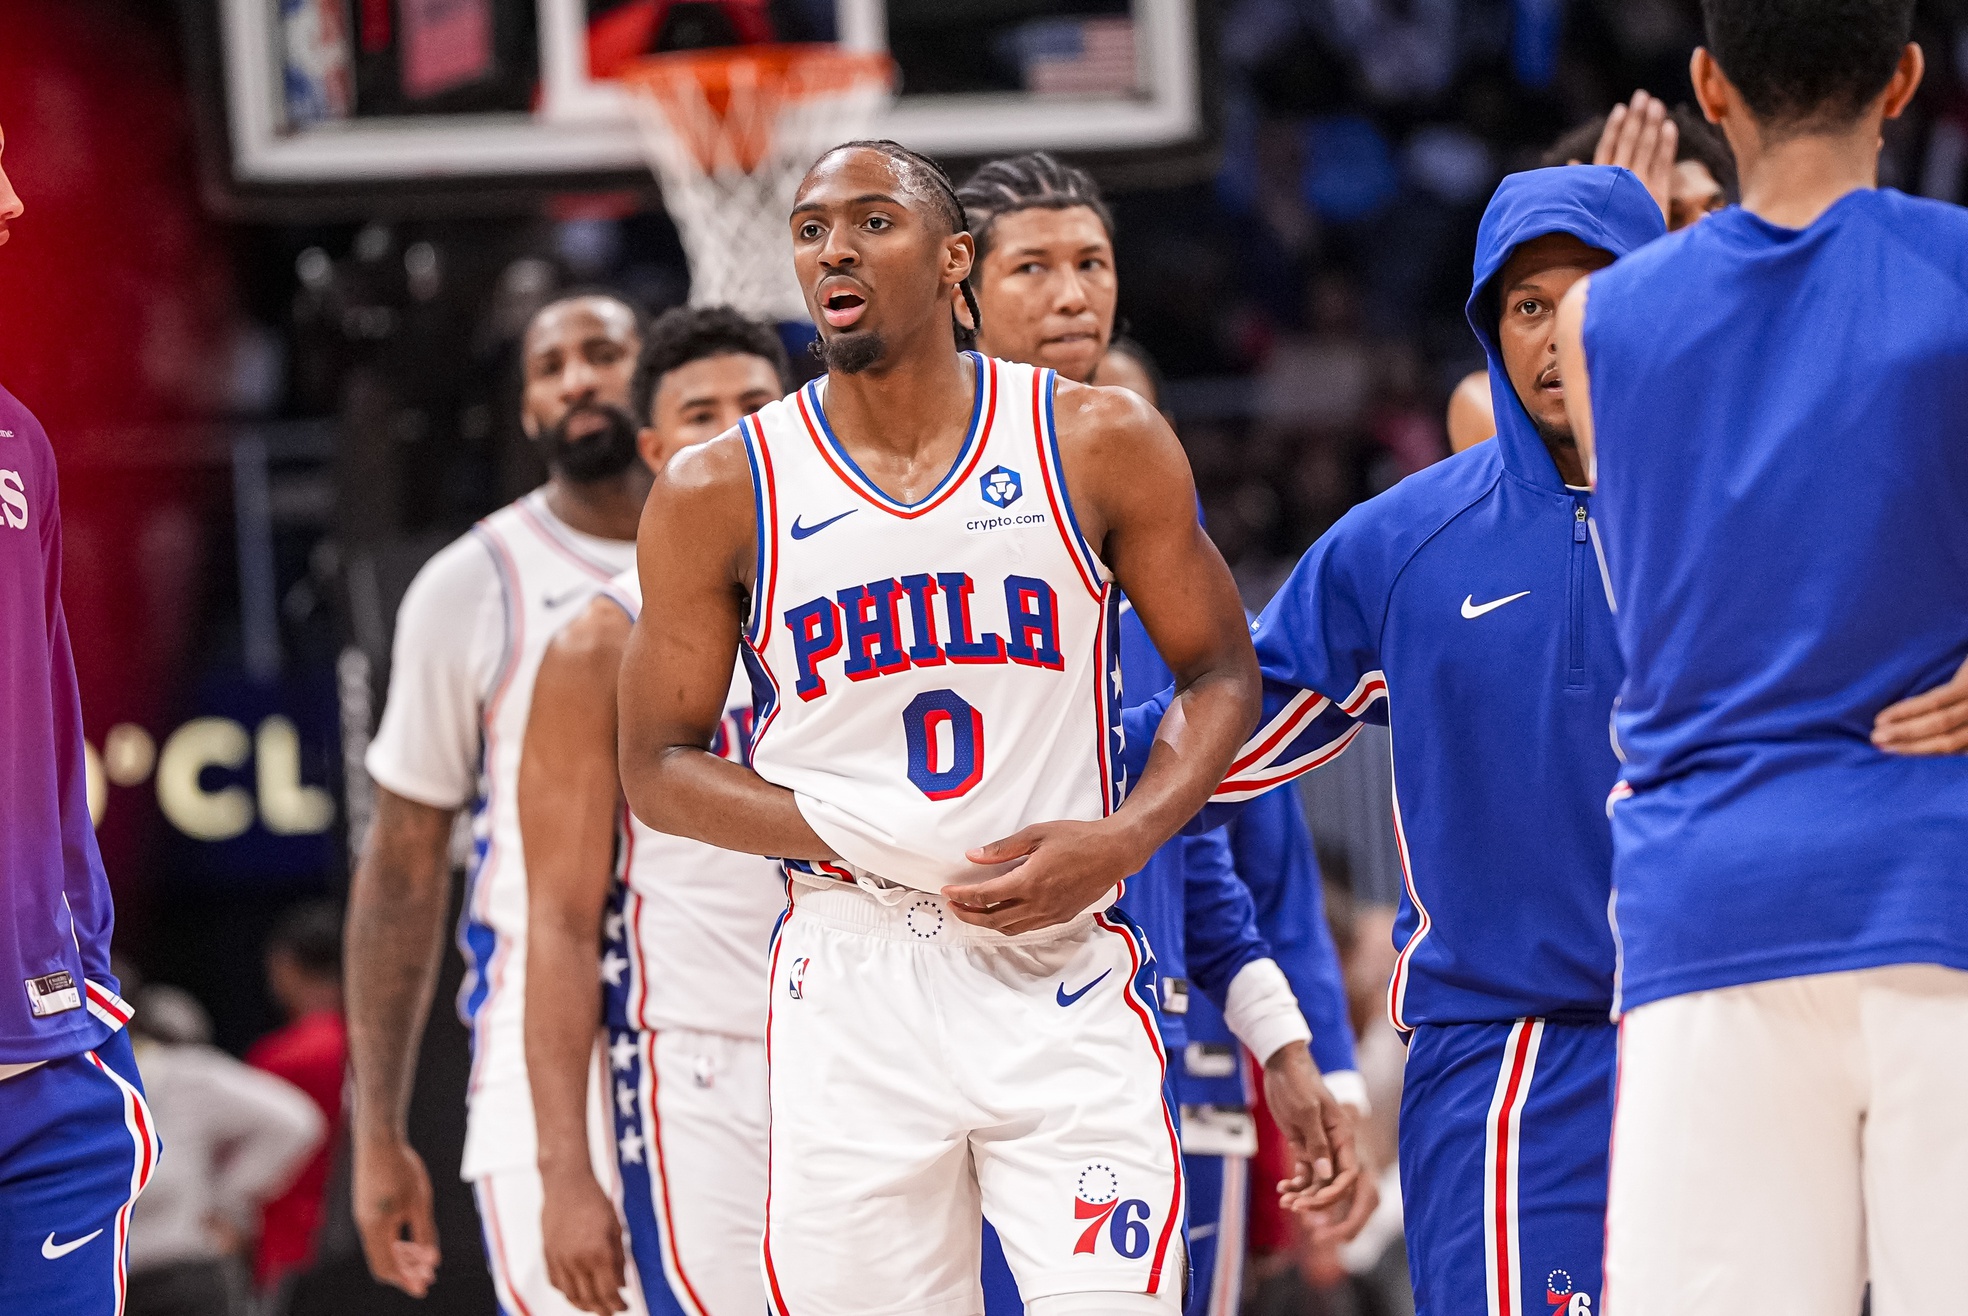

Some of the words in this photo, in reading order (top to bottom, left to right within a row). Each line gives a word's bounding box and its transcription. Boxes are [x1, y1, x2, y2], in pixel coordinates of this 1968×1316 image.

[966, 513, 1045, 531] crypto.com
[783, 572, 1065, 702] PHILA
[85, 714, 337, 841] 'CL
[902, 689, 984, 802] 0
[1072, 1194, 1151, 1260] 76
[1546, 1288, 1592, 1316] 76
